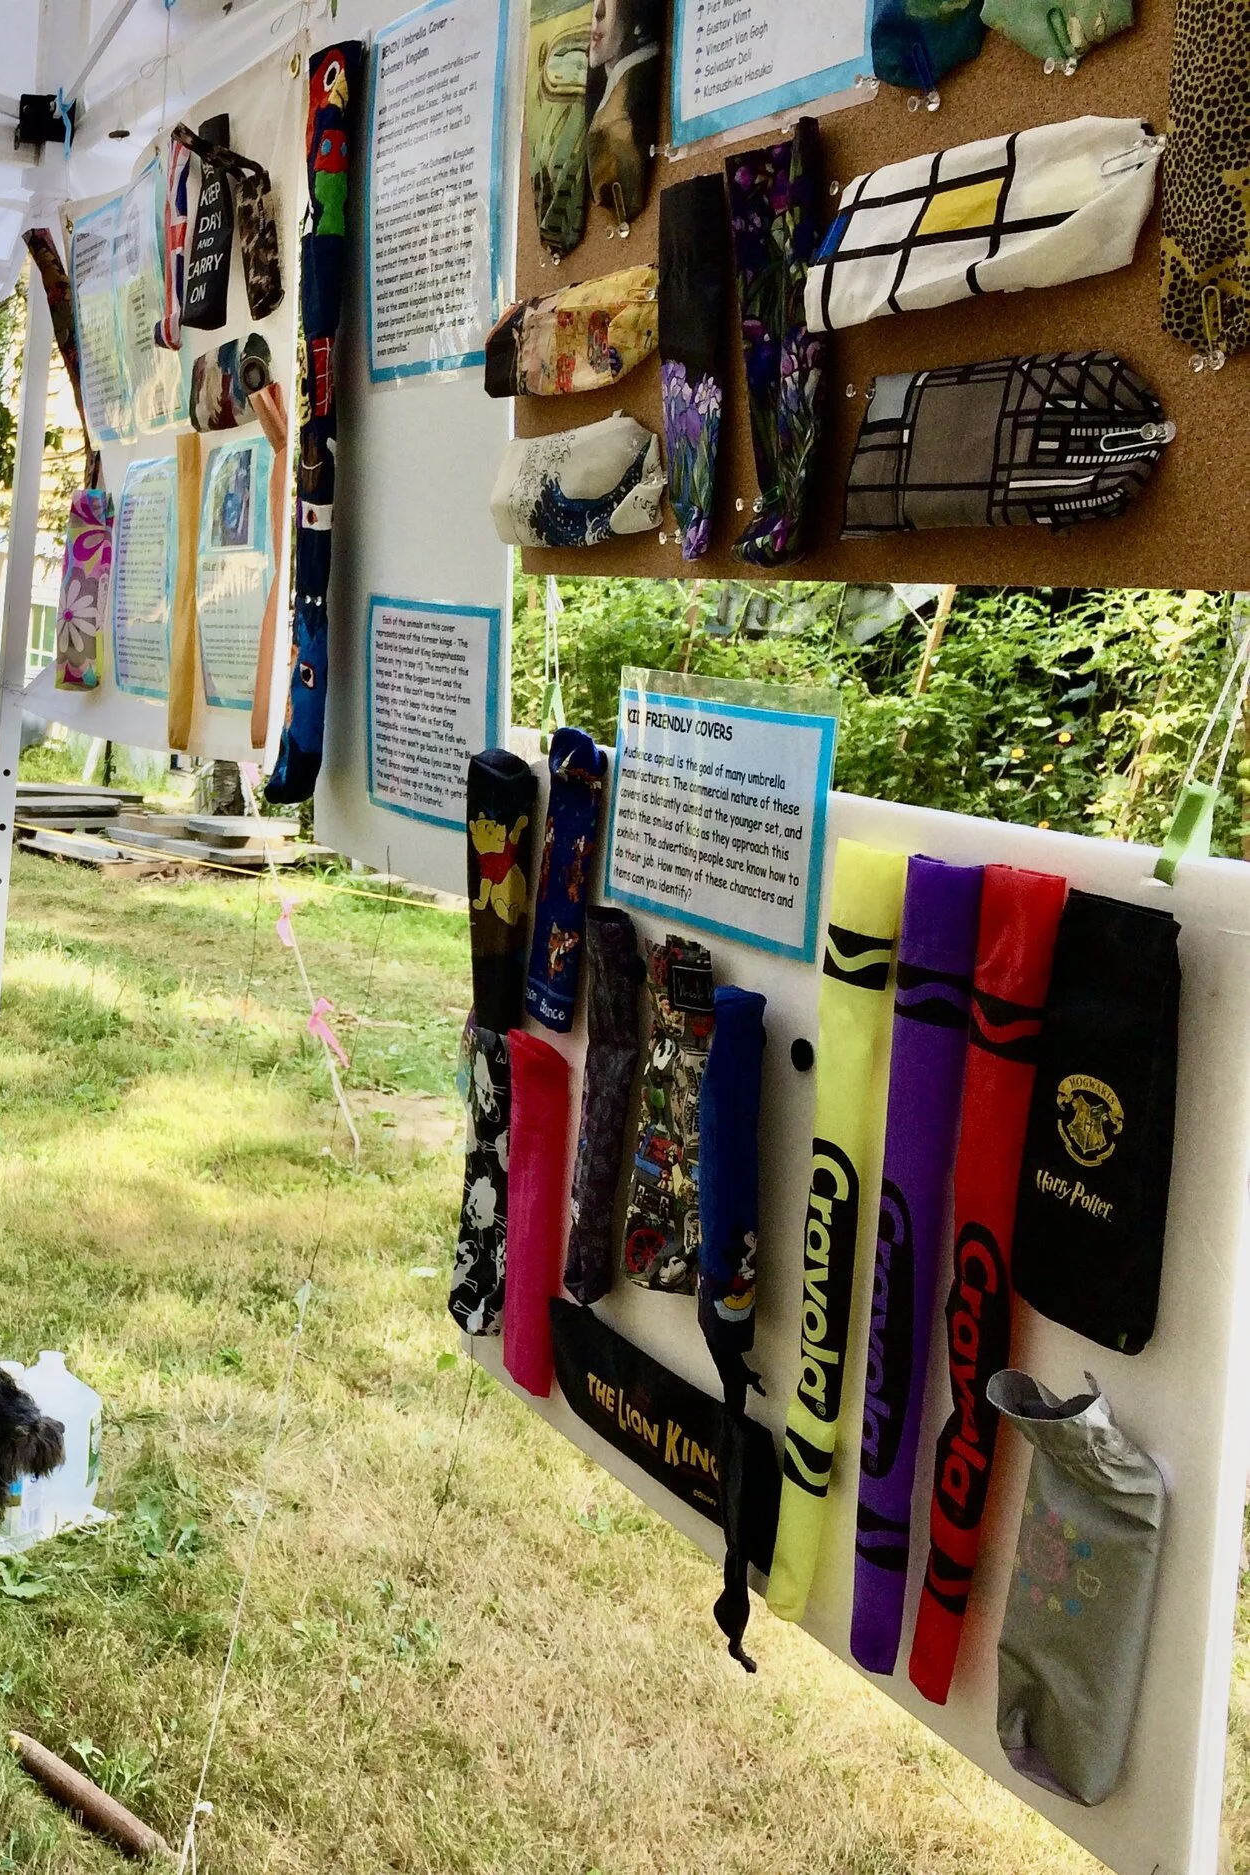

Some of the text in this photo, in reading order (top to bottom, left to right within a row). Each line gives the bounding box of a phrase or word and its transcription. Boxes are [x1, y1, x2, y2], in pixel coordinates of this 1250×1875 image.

[429, 17, 448, 34] Cover
[705, 19, 768, 56] Vincent Van Gogh
[706, 7, 751, 36] Gustav Klimt
[704, 56, 736, 77] Salvador
[200, 181, 221, 207] KEEP
[196, 237, 215, 251] AND
[187, 253, 224, 280] CARRY
[190, 283, 207, 304] ON
[645, 711, 692, 733] FRIENDLY
[695, 720, 732, 741] COVERS
[654, 754, 675, 768] appeal
[676, 755, 684, 769] is
[685, 757, 697, 771] the
[698, 762, 713, 777] goal
[714, 763, 724, 777] of
[725, 769, 746, 785] many
[747, 772, 785, 789] umbrella
[673, 776, 688, 791] The
[730, 792, 758, 807] nature
[759, 795, 770, 810] of
[772, 798, 800, 816] these
[641, 793, 648, 803] is
[703, 807, 713, 819] at
[714, 808, 728, 823] the
[730, 815, 762, 832] younger
[764, 822, 782, 837] set,
[784, 826, 803, 840] and
[638, 810, 651, 824] the
[674, 820, 684, 833] of
[700, 830, 710, 840] as
[712, 829, 730, 848] they
[731, 838, 769, 855] approach
[771, 844, 789, 861] this
[643, 832, 656, 847] The
[658, 838, 697, 862] advertising
[698, 850, 724, 867] people
[725, 858, 744, 872] sure
[746, 859, 767, 878] know
[768, 866, 786, 883] how
[788, 872, 799, 886] to
[614, 845, 623, 858] do
[657, 857, 673, 872] How
[674, 865, 693, 881] many
[694, 868, 703, 882] of
[705, 871, 727, 889] these
[729, 879, 775, 903] characters
[776, 895, 794, 908] and
[631, 873, 644, 885] can
[658, 879, 692, 902] identify?
[1069, 1077, 1117, 1105] HOGWARTS
[1036, 1169, 1114, 1222] Harry Potter
[800, 1154, 849, 1404] Crayola
[587, 1372, 615, 1412] THE
[618, 1387, 659, 1448] LION
